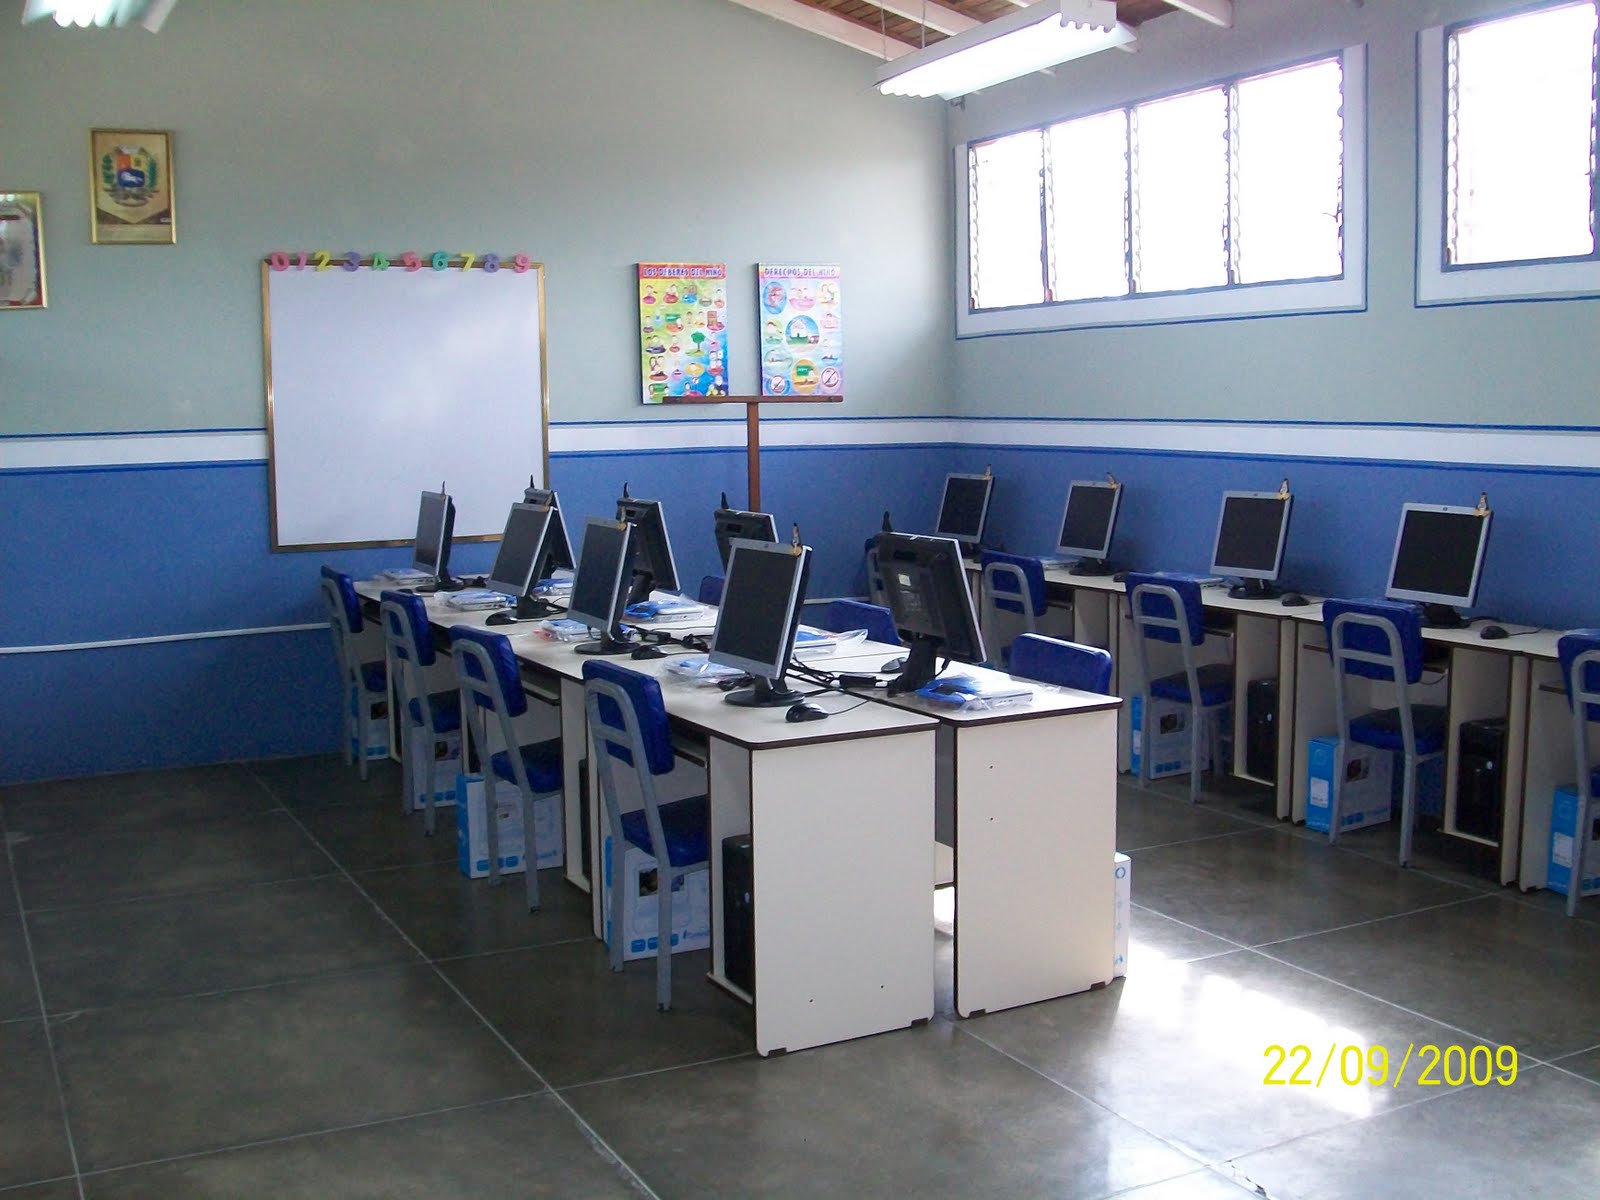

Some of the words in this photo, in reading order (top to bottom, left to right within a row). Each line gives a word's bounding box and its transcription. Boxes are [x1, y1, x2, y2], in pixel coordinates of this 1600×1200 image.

[271, 251, 290, 271] 0
[297, 251, 307, 271] 1
[314, 251, 333, 272] 2
[343, 251, 360, 272] 3
[372, 252, 389, 271] 4
[401, 251, 422, 272] 5
[432, 252, 448, 271] 6
[459, 252, 476, 272] 7
[483, 253, 500, 273] 8
[513, 253, 531, 273] 9
[644, 267, 656, 276] LOS
[659, 267, 688, 276] DEBERES
[691, 267, 703, 277] DEL
[764, 267, 800, 276] DERECHOS
[803, 268, 815, 276] DEL
